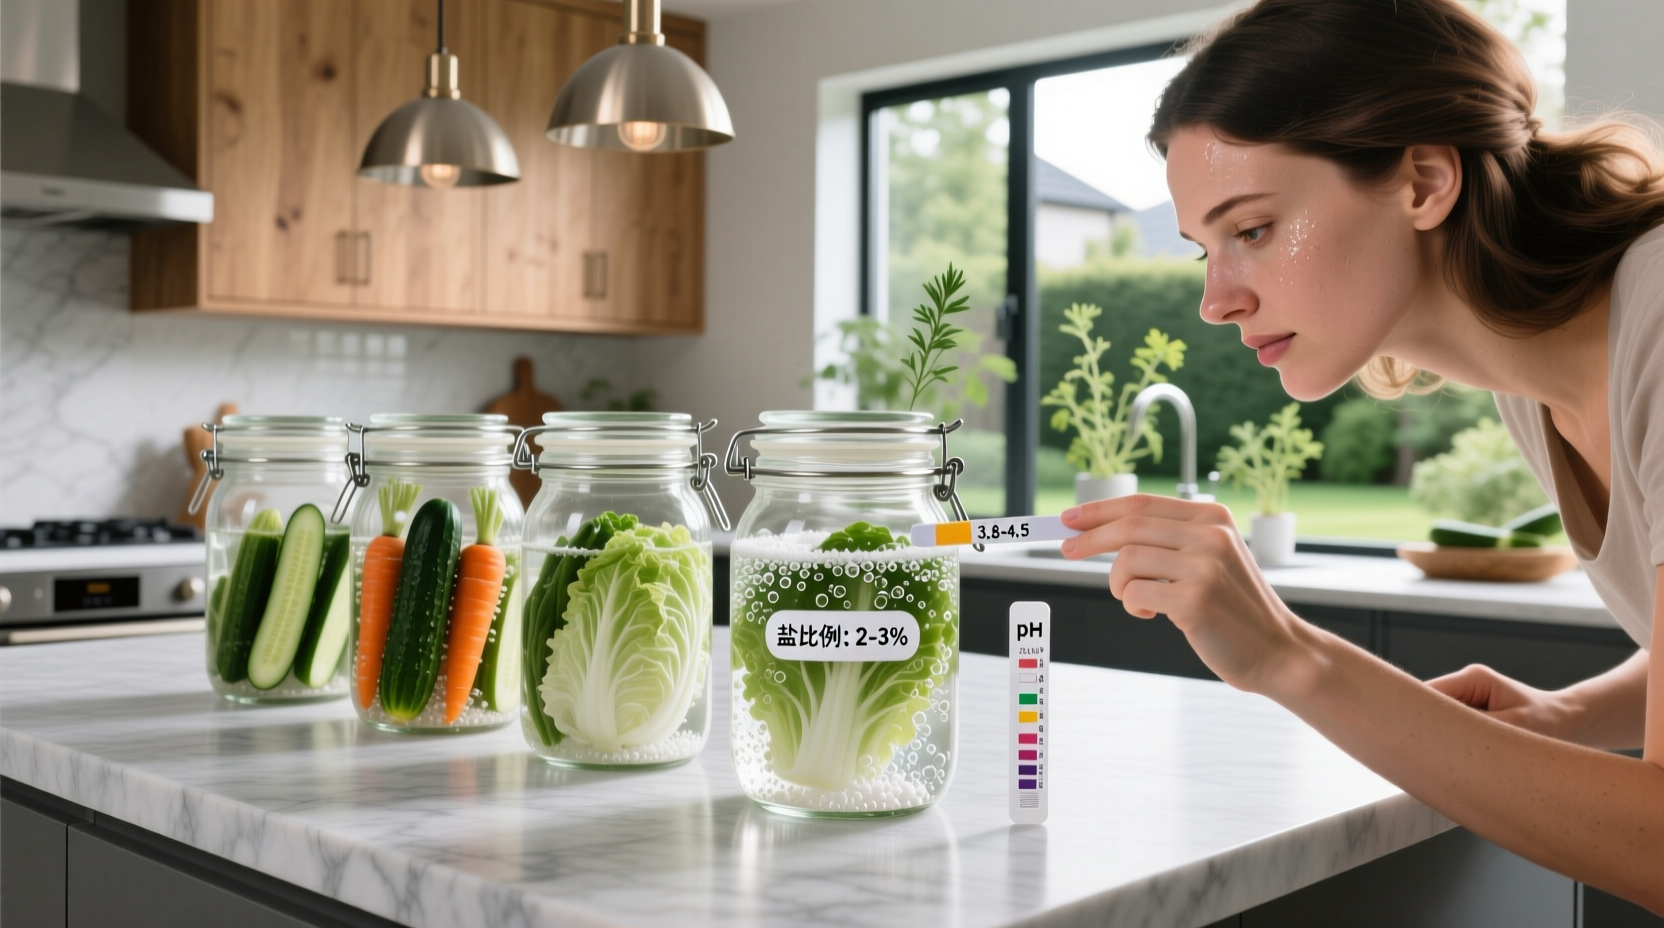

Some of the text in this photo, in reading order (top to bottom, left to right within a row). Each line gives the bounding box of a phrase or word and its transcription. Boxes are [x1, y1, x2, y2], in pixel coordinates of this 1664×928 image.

[977, 523, 1030, 540] 3.8-4.5
[856, 627, 909, 646] 2-3%
[1017, 622, 1042, 641] pH
